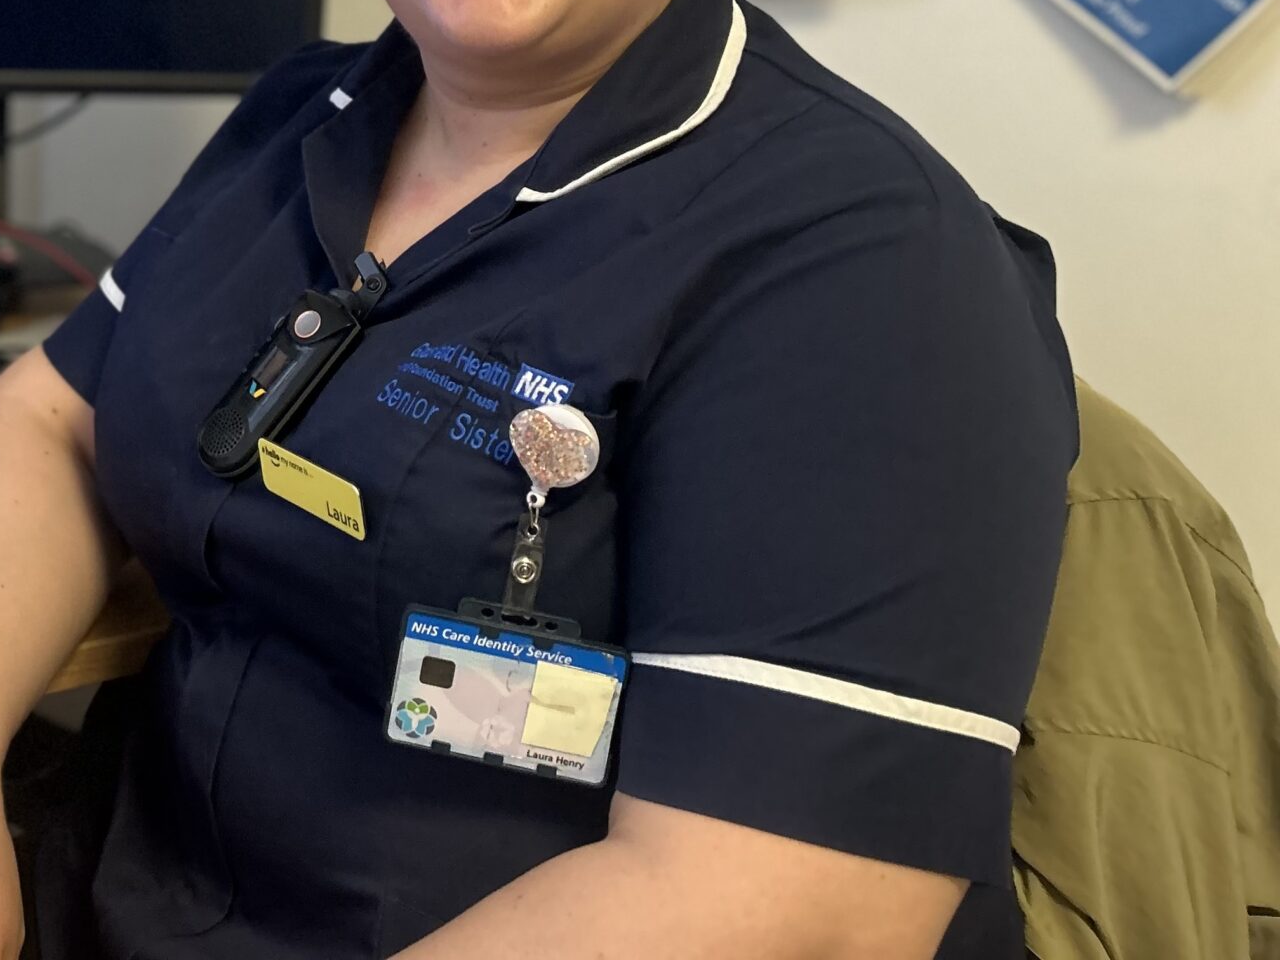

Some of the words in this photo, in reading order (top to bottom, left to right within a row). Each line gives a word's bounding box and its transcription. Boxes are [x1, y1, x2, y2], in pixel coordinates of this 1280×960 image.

[456, 344, 512, 391] Health
[514, 370, 570, 406] NHS
[376, 378, 440, 425] Senior
[466, 387, 500, 413] Trust
[326, 500, 360, 533] Laura
[411, 621, 439, 637] NHS
[442, 628, 471, 644] Care
[473, 634, 524, 657] Identity
[526, 646, 573, 665] Service
[526, 748, 554, 763] Laura
[556, 755, 586, 771] Henry
